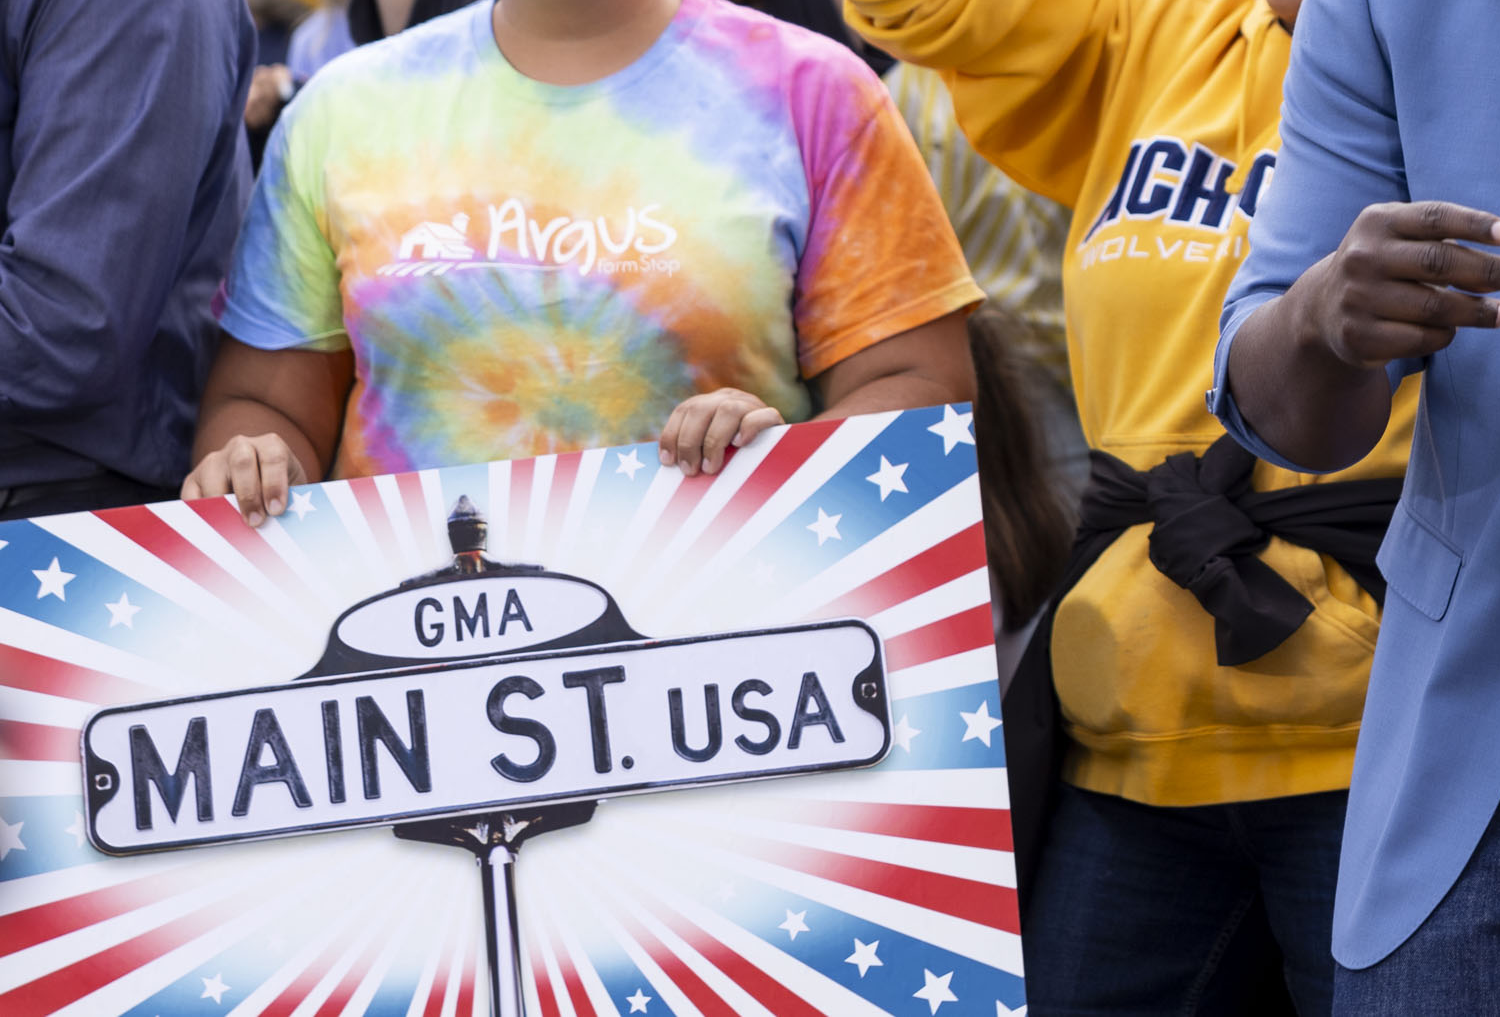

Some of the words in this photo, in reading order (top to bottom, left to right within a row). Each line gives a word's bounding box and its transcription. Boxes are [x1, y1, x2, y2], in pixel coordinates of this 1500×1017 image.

[485, 197, 678, 276] Argus
[413, 586, 534, 648] GMA
[129, 688, 432, 831] MAIN
[485, 664, 635, 784] ST.
[667, 670, 846, 765] USA
